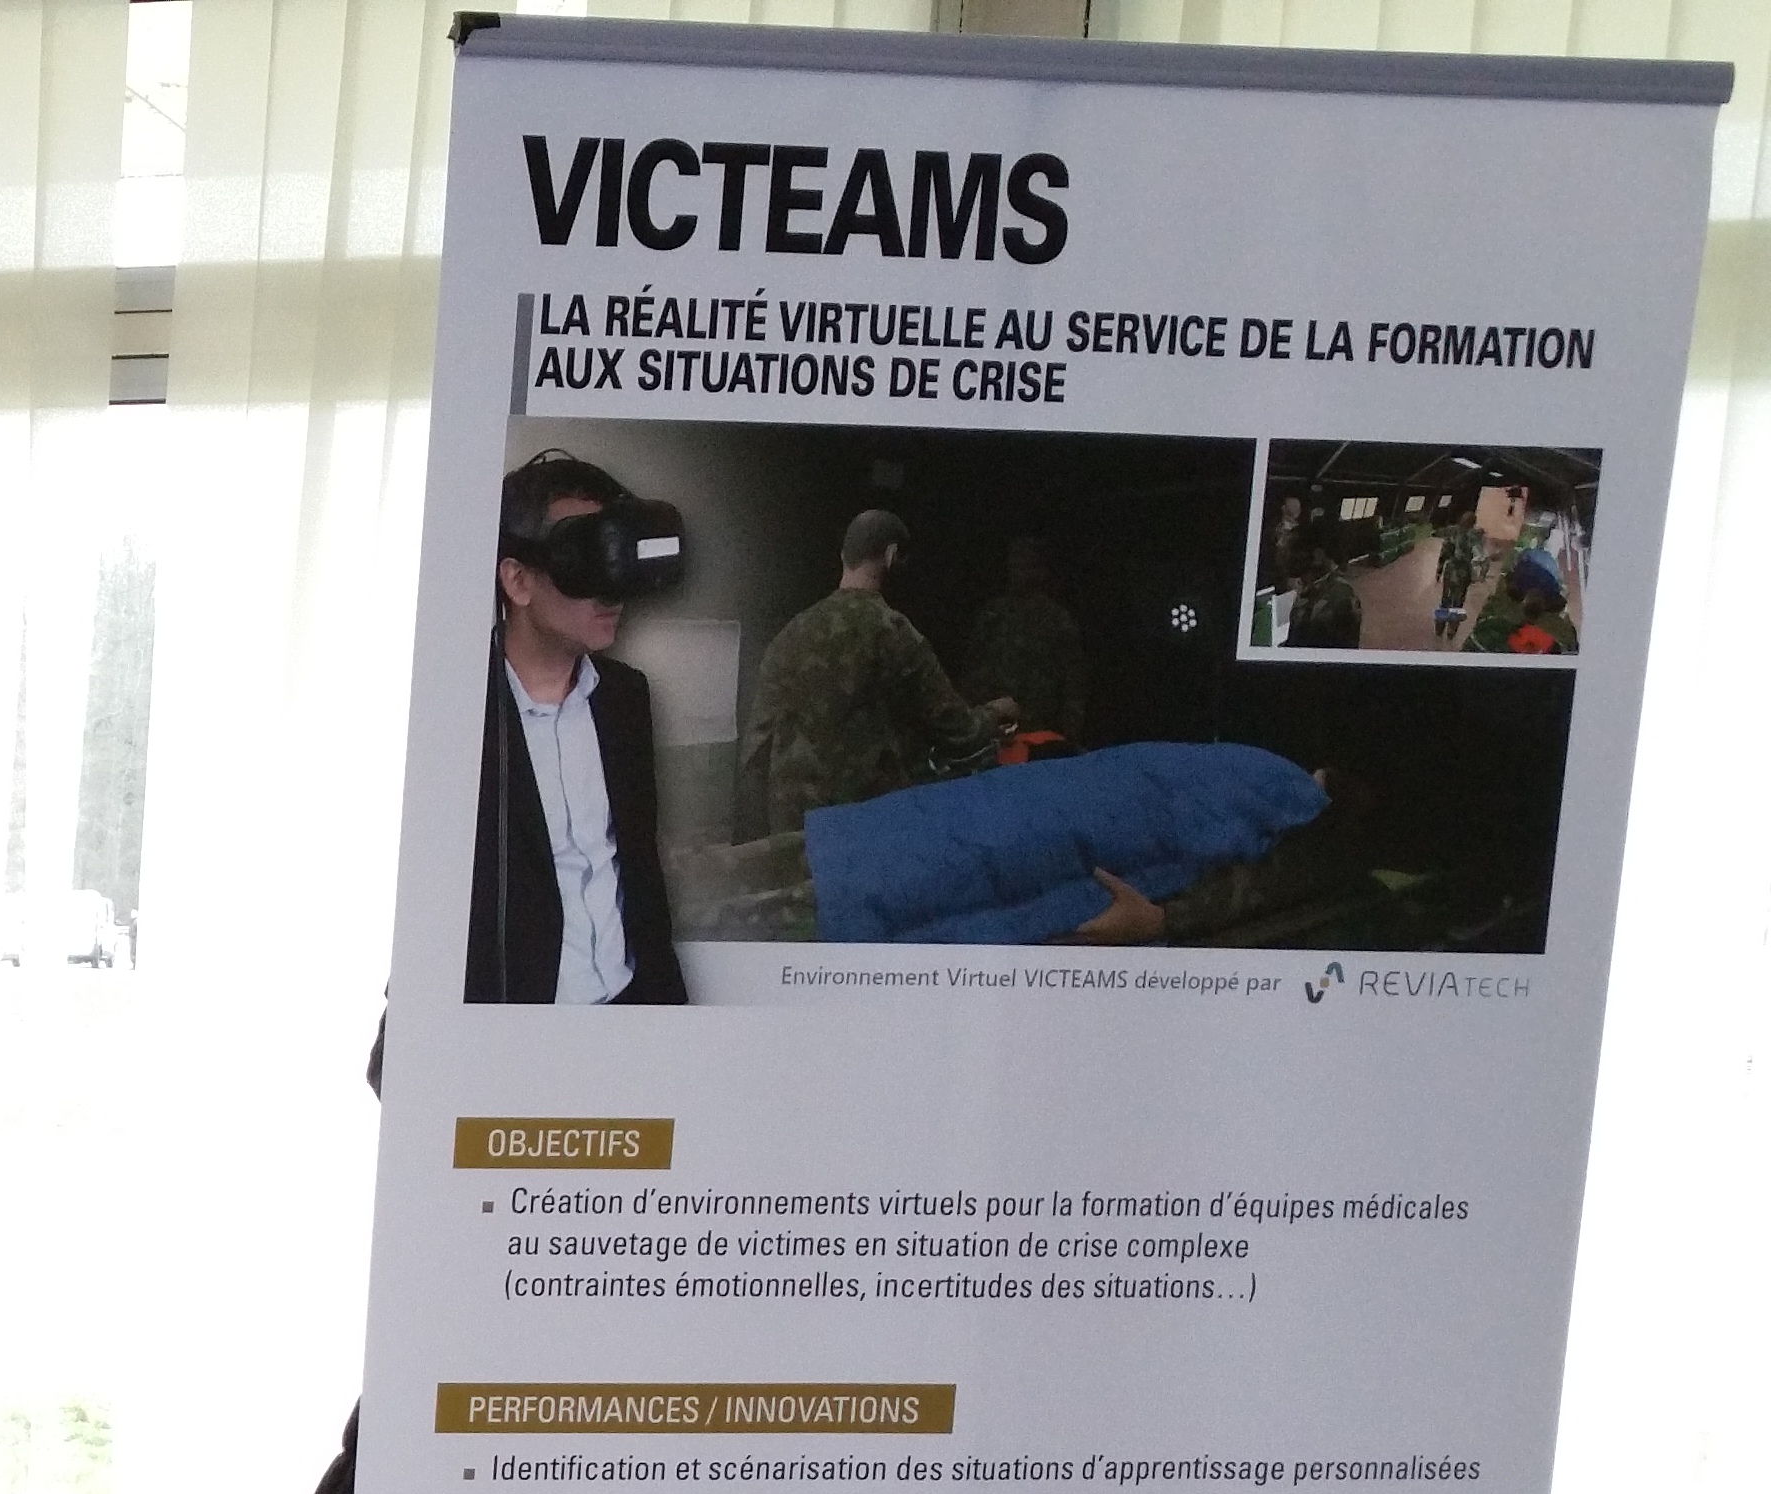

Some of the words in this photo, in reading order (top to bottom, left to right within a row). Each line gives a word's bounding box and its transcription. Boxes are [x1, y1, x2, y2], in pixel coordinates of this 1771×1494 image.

[523, 135, 1069, 265] VICTEAMS
[541, 294, 590, 336] LA
[605, 284, 767, 341] RÉALITÉ
[780, 301, 986, 348] VIRTUELLE
[995, 309, 1053, 351] AU
[1066, 311, 1227, 357] SERVICE
[1240, 318, 1293, 359] DE
[1306, 320, 1354, 361] LA
[1368, 323, 1595, 369] FORMATION
[535, 347, 625, 389] AUX
[638, 349, 875, 397] SITUATIONS
[889, 357, 940, 399] DE
[953, 359, 1066, 403] CRISE
[782, 966, 939, 986] Environnement
[947, 968, 1016, 987] Virtuel
[1025, 969, 1128, 988] VICTEAMS
[1135, 970, 1239, 995] développé
[1246, 978, 1281, 996] par
[488, 1129, 640, 1157] OBJECTIFS
[512, 1187, 622, 1214] Création
[880, 1190, 977, 1216] virtuels
[986, 1198, 1044, 1222] pour
[1053, 1191, 1072, 1216] la
[1082, 1191, 1200, 1216] formation
[1343, 1194, 1468, 1220] médicales
[508, 1237, 538, 1255] au
[549, 1234, 687, 1262] sauvetage
[698, 1230, 727, 1256] de
[738, 1230, 845, 1256] victimes
[856, 1238, 886, 1256] en
[896, 1231, 1008, 1257] situation
[1019, 1232, 1048, 1257] de
[1058, 1232, 1117, 1257] crise
[1127, 1232, 1248, 1263] complexe
[505, 1270, 665, 1300] (contraintes
[676, 1271, 865, 1301] émotionnelles,
[876, 1272, 1032, 1298] incertitudes
[1042, 1273, 1085, 1298] des
[469, 1396, 699, 1423] PERFORMANCES
[726, 1396, 919, 1423] INNOVATIONS
[493, 1455, 665, 1480] Identification
[676, 1459, 701, 1480] et
[709, 1455, 886, 1480] scénarisation
[897, 1456, 942, 1481] des
[952, 1455, 1073, 1481] situations
[1294, 1455, 1480, 1486] personnalisées
